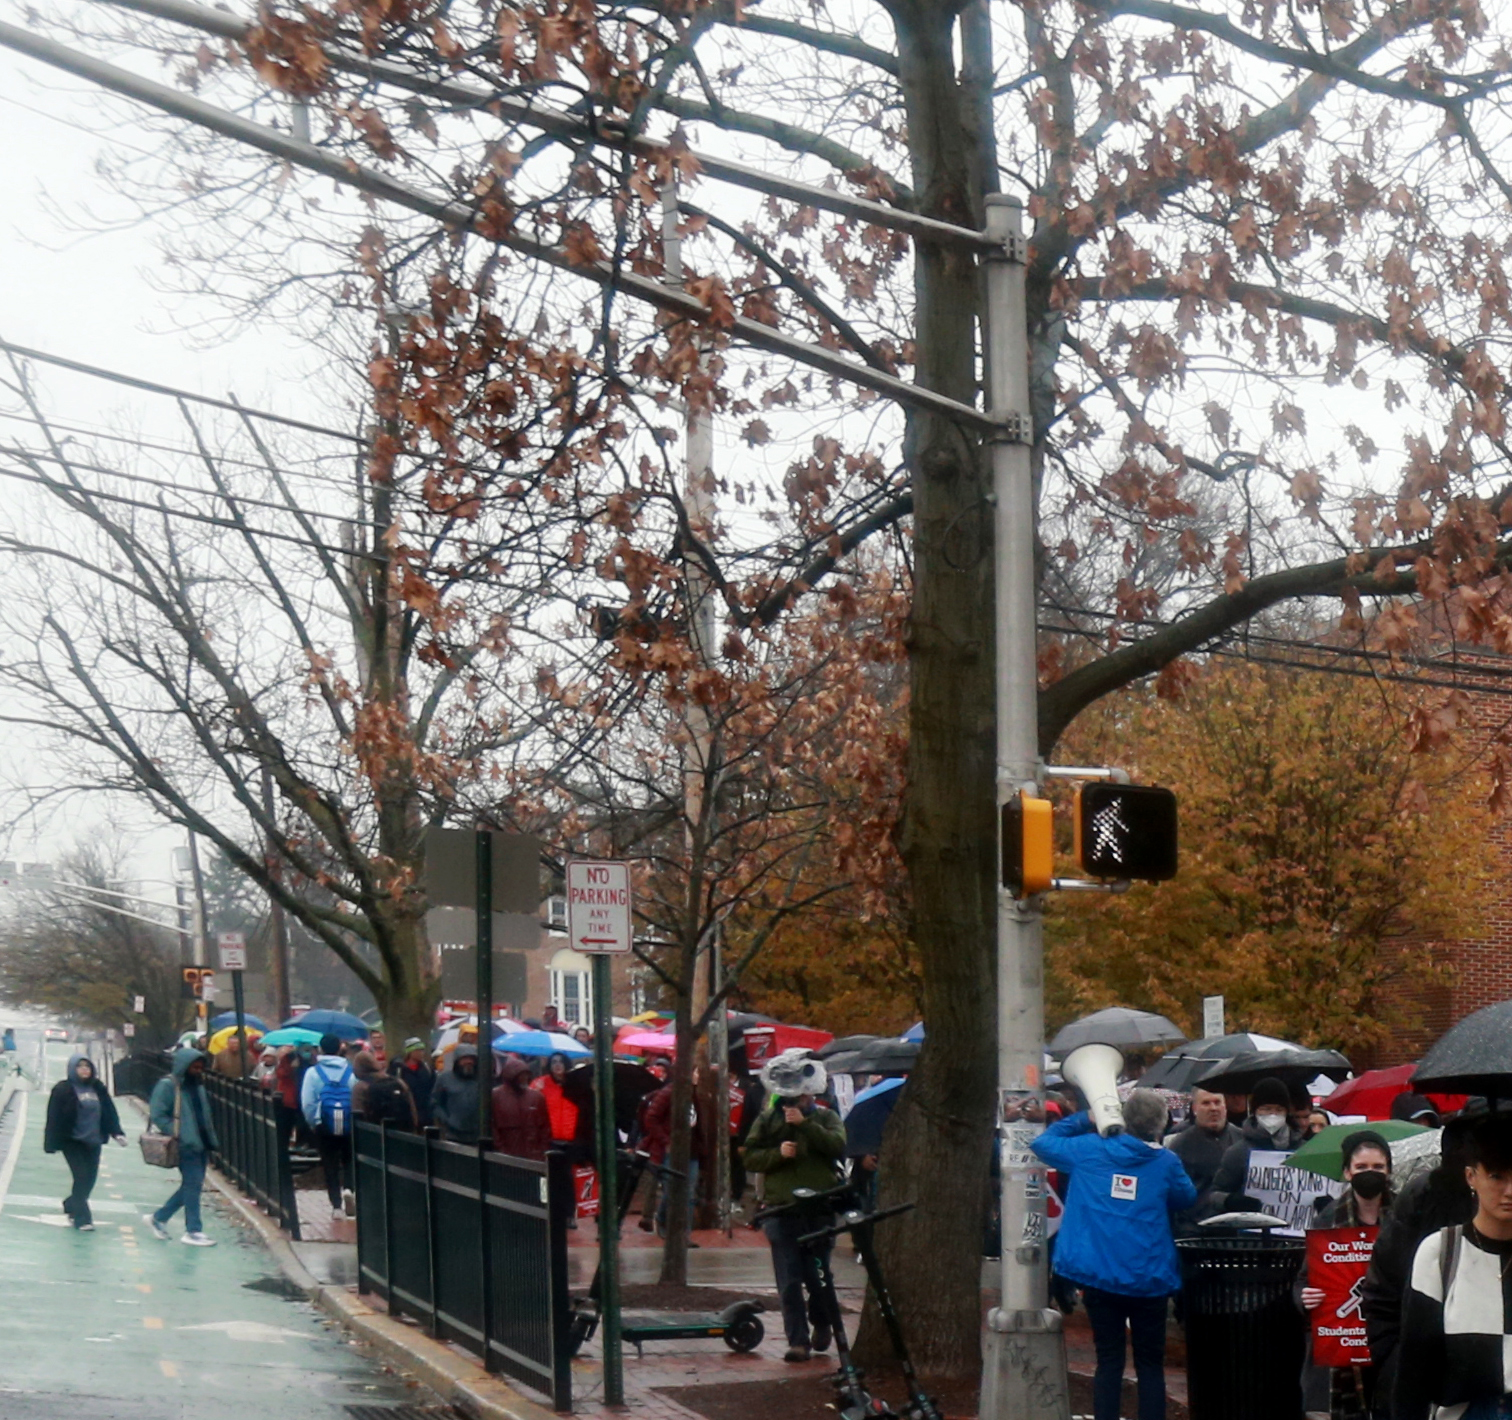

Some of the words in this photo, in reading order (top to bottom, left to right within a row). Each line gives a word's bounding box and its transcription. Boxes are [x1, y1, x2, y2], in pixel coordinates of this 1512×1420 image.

[587, 868, 609, 884] NO
[571, 888, 627, 905] PARKING
[591, 910, 609, 919] ANY
[589, 923, 612, 933] TIME
[1279, 1192, 1301, 1204] ON
[1328, 1242, 1349, 1252] Our
[1318, 1326, 1366, 1336] Students
